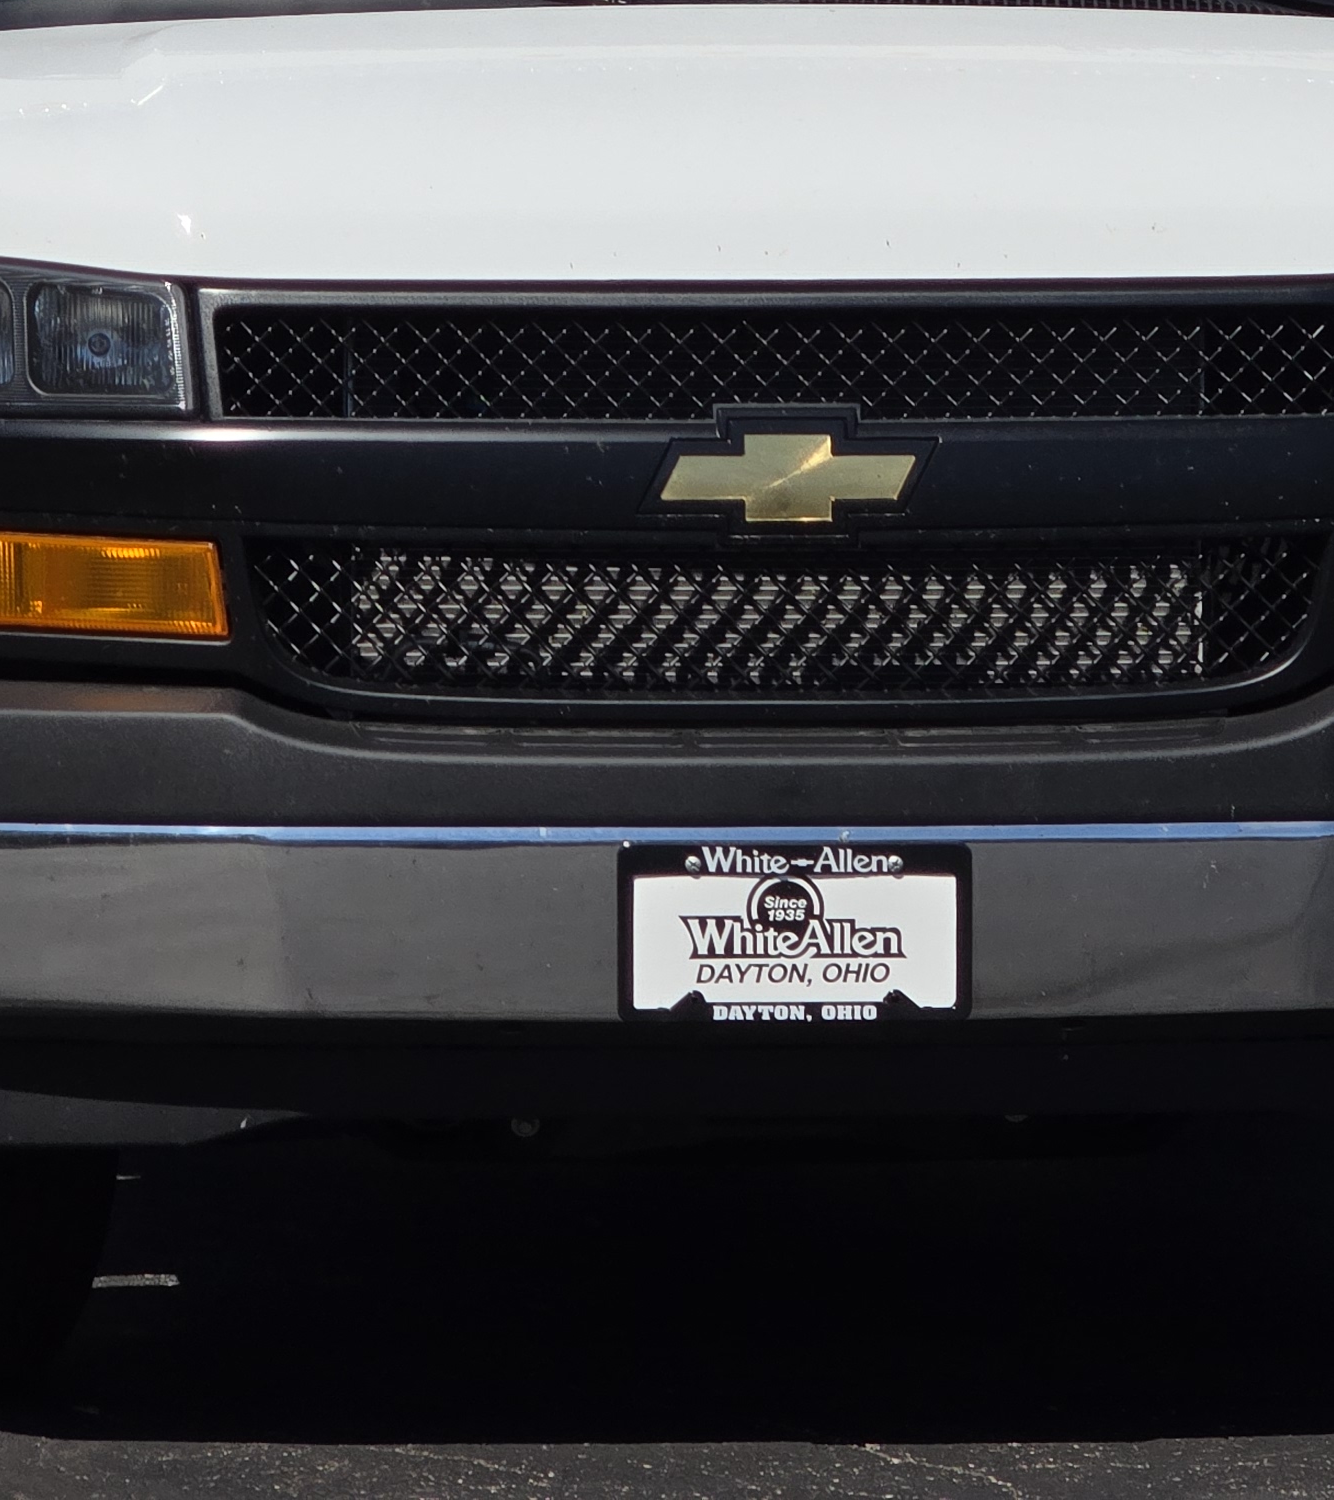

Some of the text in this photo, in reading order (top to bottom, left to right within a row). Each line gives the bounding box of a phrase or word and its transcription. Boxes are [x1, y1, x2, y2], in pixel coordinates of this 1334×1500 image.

[763, 896, 808, 909] Since
[767, 909, 806, 922] 1935
[695, 963, 891, 987] DAYTON, OHIO
[712, 1004, 878, 1022] DAYTON, OHIO
